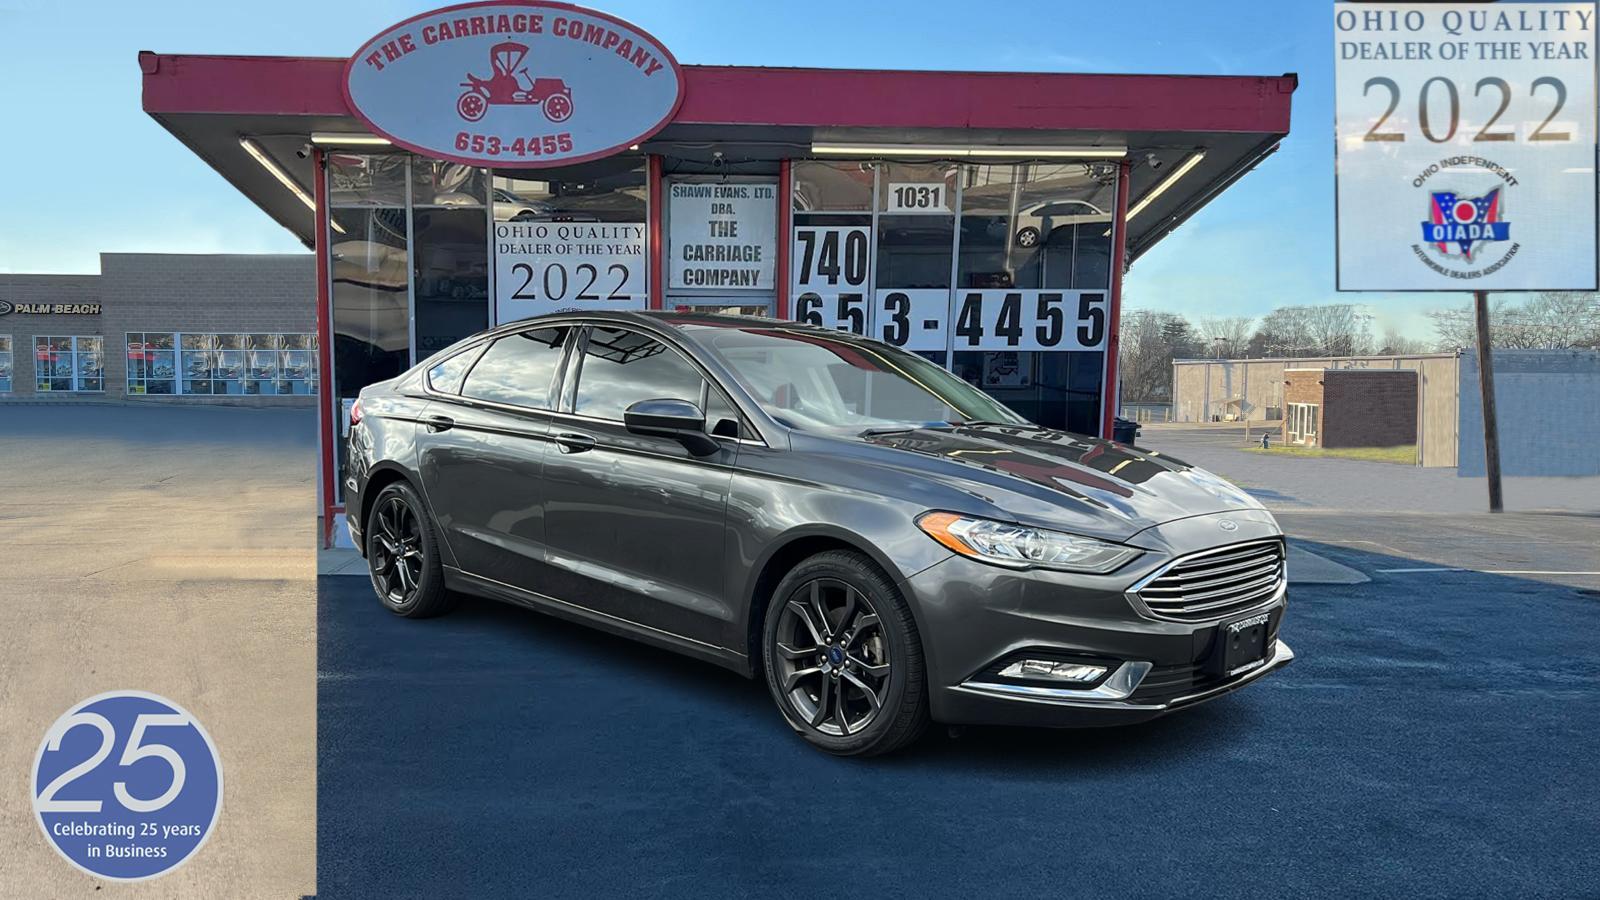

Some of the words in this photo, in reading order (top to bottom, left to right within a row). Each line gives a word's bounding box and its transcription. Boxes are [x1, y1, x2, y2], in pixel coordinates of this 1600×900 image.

[1336, 10, 1425, 32] OHIO
[1442, 10, 1592, 35] QUALITY
[365, 33, 416, 71] THE
[422, 14, 544, 45] CARRIAGE
[552, 16, 664, 77] COMPANY
[1340, 41, 1433, 60] DEALER
[1438, 41, 1469, 60] OF
[1475, 42, 1522, 60] THE
[1528, 41, 1589, 60] YEAR
[1363, 76, 1571, 143] 2022
[455, 132, 573, 156] 653-4455
[1412, 164, 1439, 188] OHIO
[1440, 155, 1519, 187] INDEPENDENT
[672, 186, 711, 198] SHAWN
[754, 187, 775, 200] LTD.
[894, 187, 941, 208] 1031
[711, 203, 736, 215] DBA.
[497, 226, 548, 239] OHIO
[557, 226, 644, 241] QUALITY
[708, 220, 738, 238] THE
[1432, 224, 1495, 240] OIADA
[499, 243, 553, 255] DEALER
[555, 243, 574, 255] OF
[576, 244, 603, 255] THE
[606, 244, 642, 255] YEAR
[683, 244, 762, 262] CARRIAGE
[796, 229, 868, 286] 740
[1449, 270, 1482, 280] DEALERS
[1483, 242, 1520, 276] ASSOCIATION
[511, 262, 632, 301] 2022
[683, 268, 760, 287] COMPANY
[15, 304, 50, 314] PALM
[54, 304, 100, 314] BEACH
